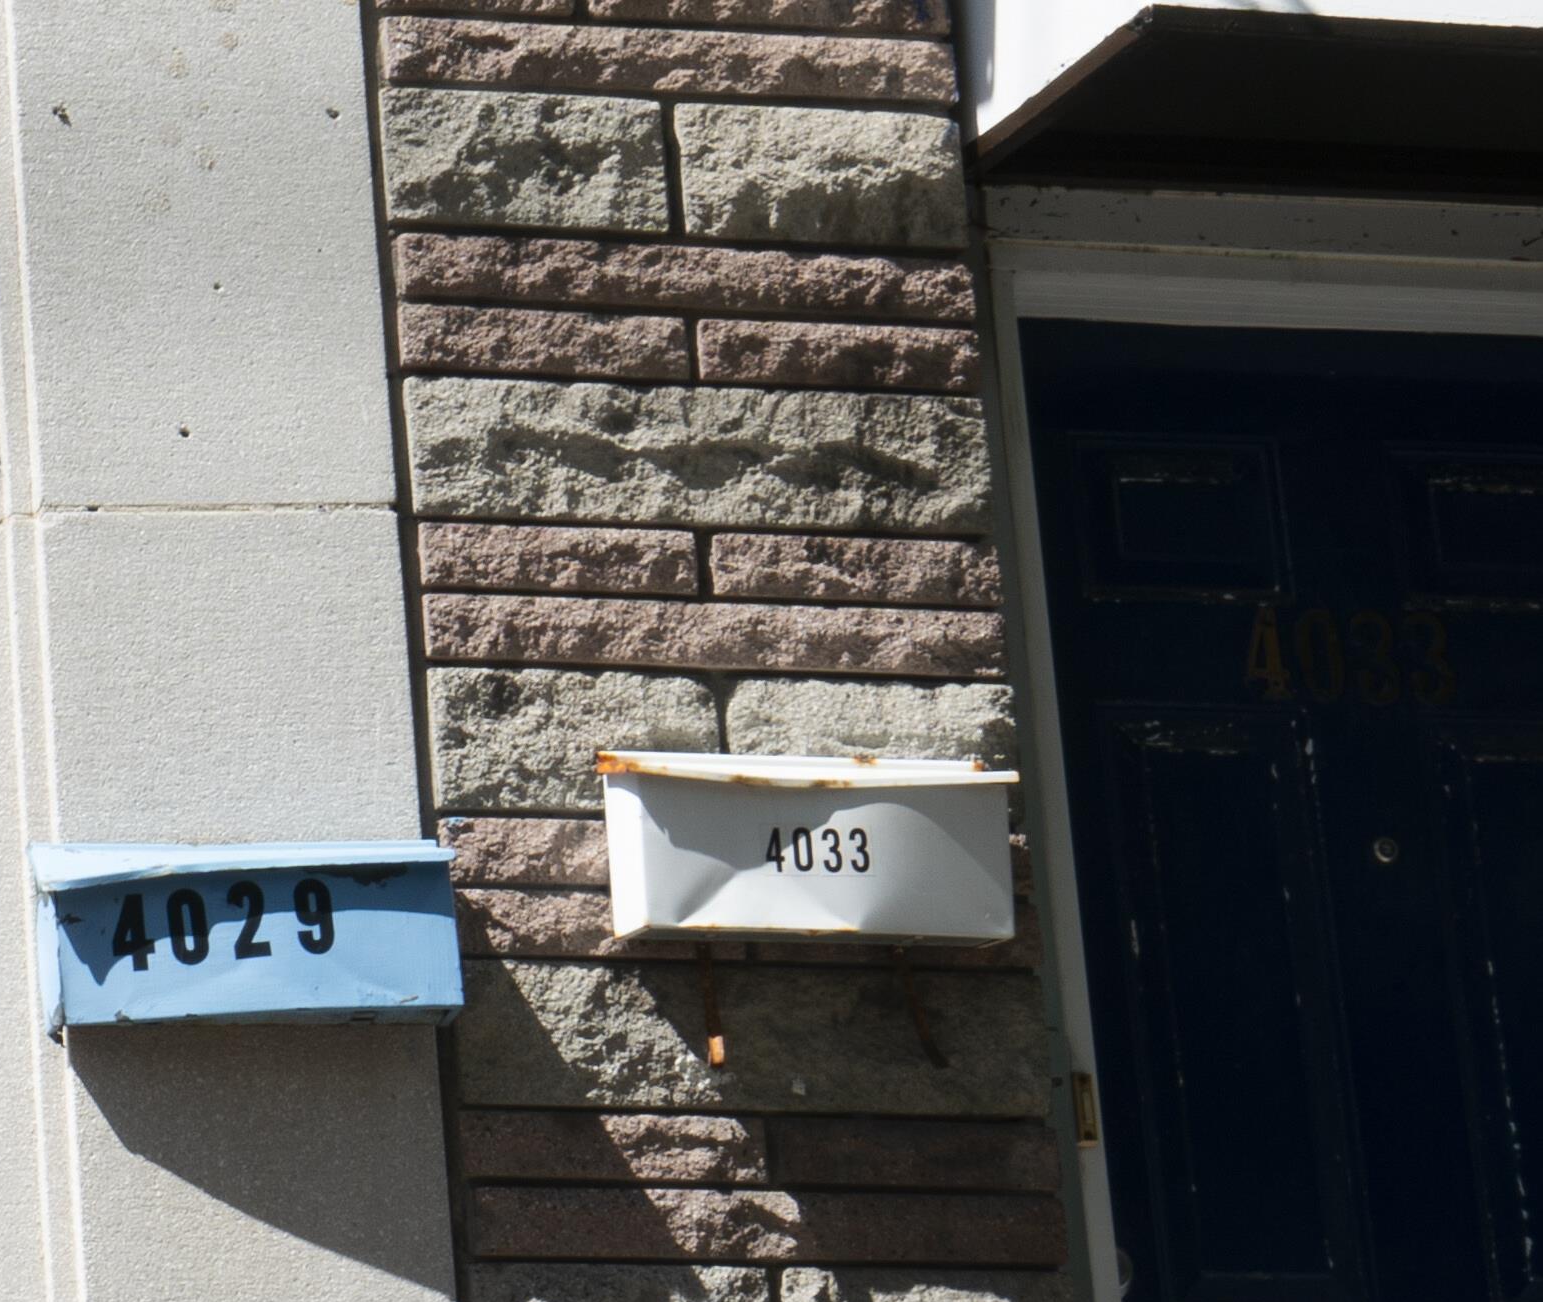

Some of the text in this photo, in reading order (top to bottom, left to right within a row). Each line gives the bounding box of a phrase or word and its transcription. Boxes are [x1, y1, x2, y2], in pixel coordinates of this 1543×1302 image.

[1244, 607, 1457, 704] 4033
[765, 826, 871, 874] 4033
[112, 877, 335, 972] 4029
